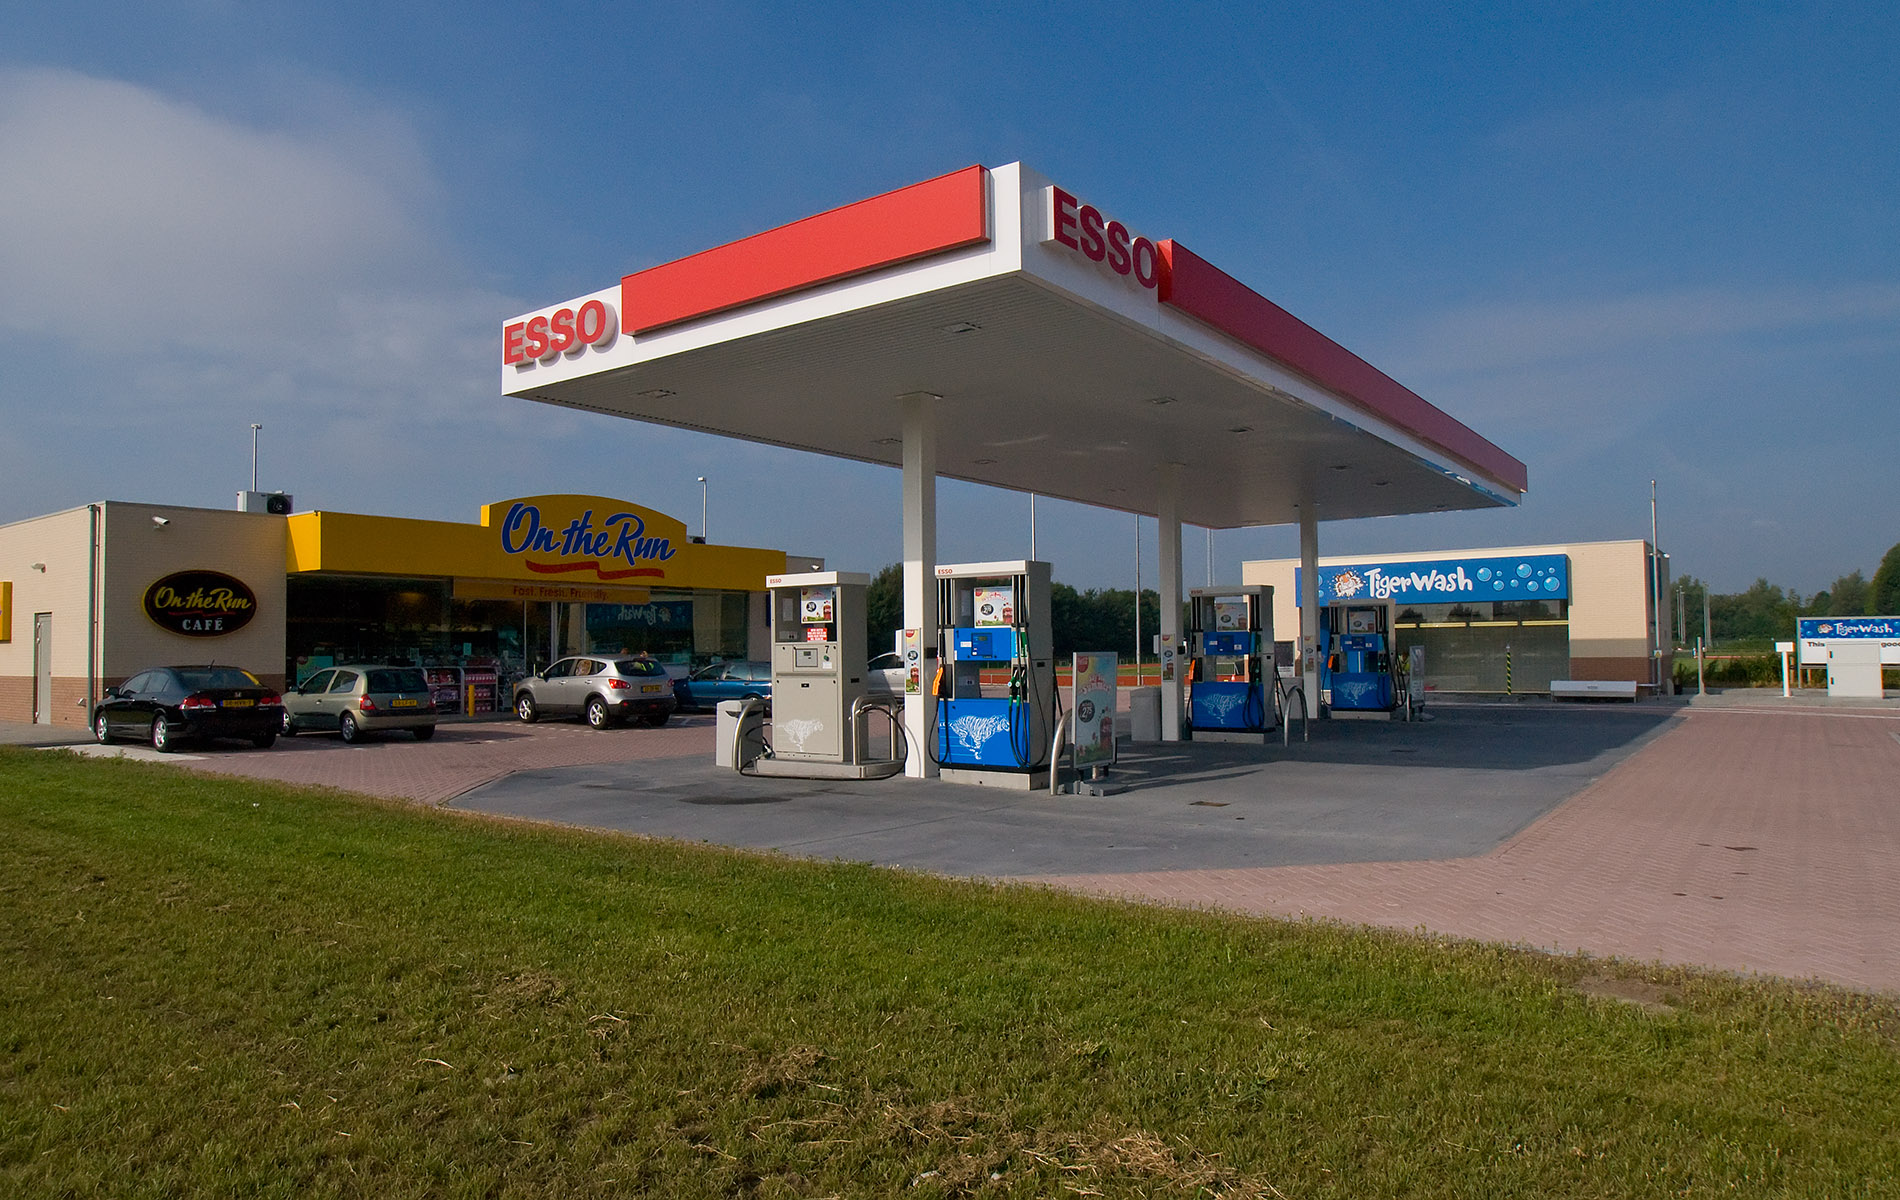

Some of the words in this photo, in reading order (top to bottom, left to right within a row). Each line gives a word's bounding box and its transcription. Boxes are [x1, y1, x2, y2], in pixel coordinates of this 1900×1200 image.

[1053, 185, 1158, 289] ESSO
[503, 300, 607, 365] ESSO
[501, 502, 561, 554] On
[560, 510, 612, 557] the
[605, 512, 677, 567] Run
[154, 586, 186, 609] On
[185, 587, 215, 609] the
[209, 587, 252, 612] Run
[1364, 566, 1473, 599] TigerWash
[824, 645, 830, 654] 7
